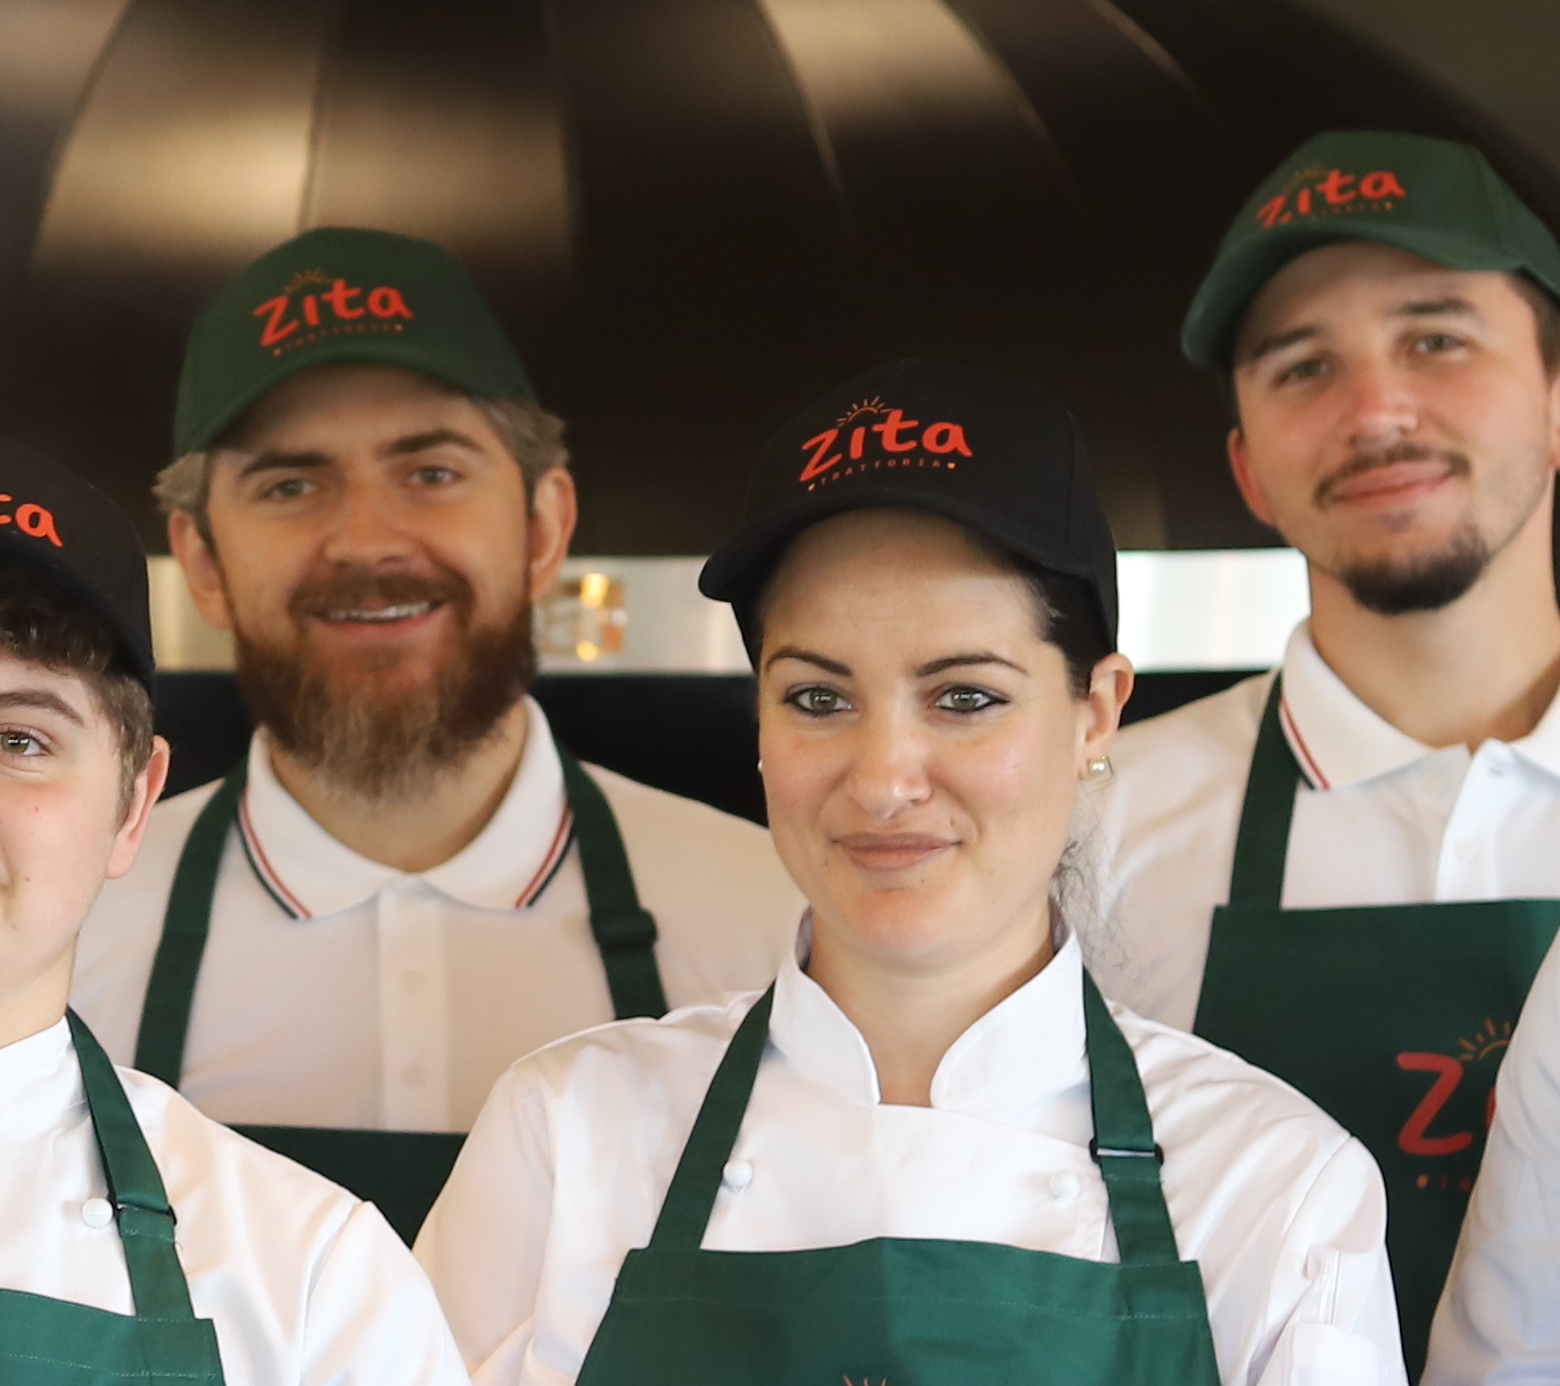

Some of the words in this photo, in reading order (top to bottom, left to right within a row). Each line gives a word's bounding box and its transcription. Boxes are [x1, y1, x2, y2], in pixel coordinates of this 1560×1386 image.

[253, 278, 415, 348] Zita
[799, 409, 974, 483] Zita
[820, 458, 941, 487] TRATTORIA
